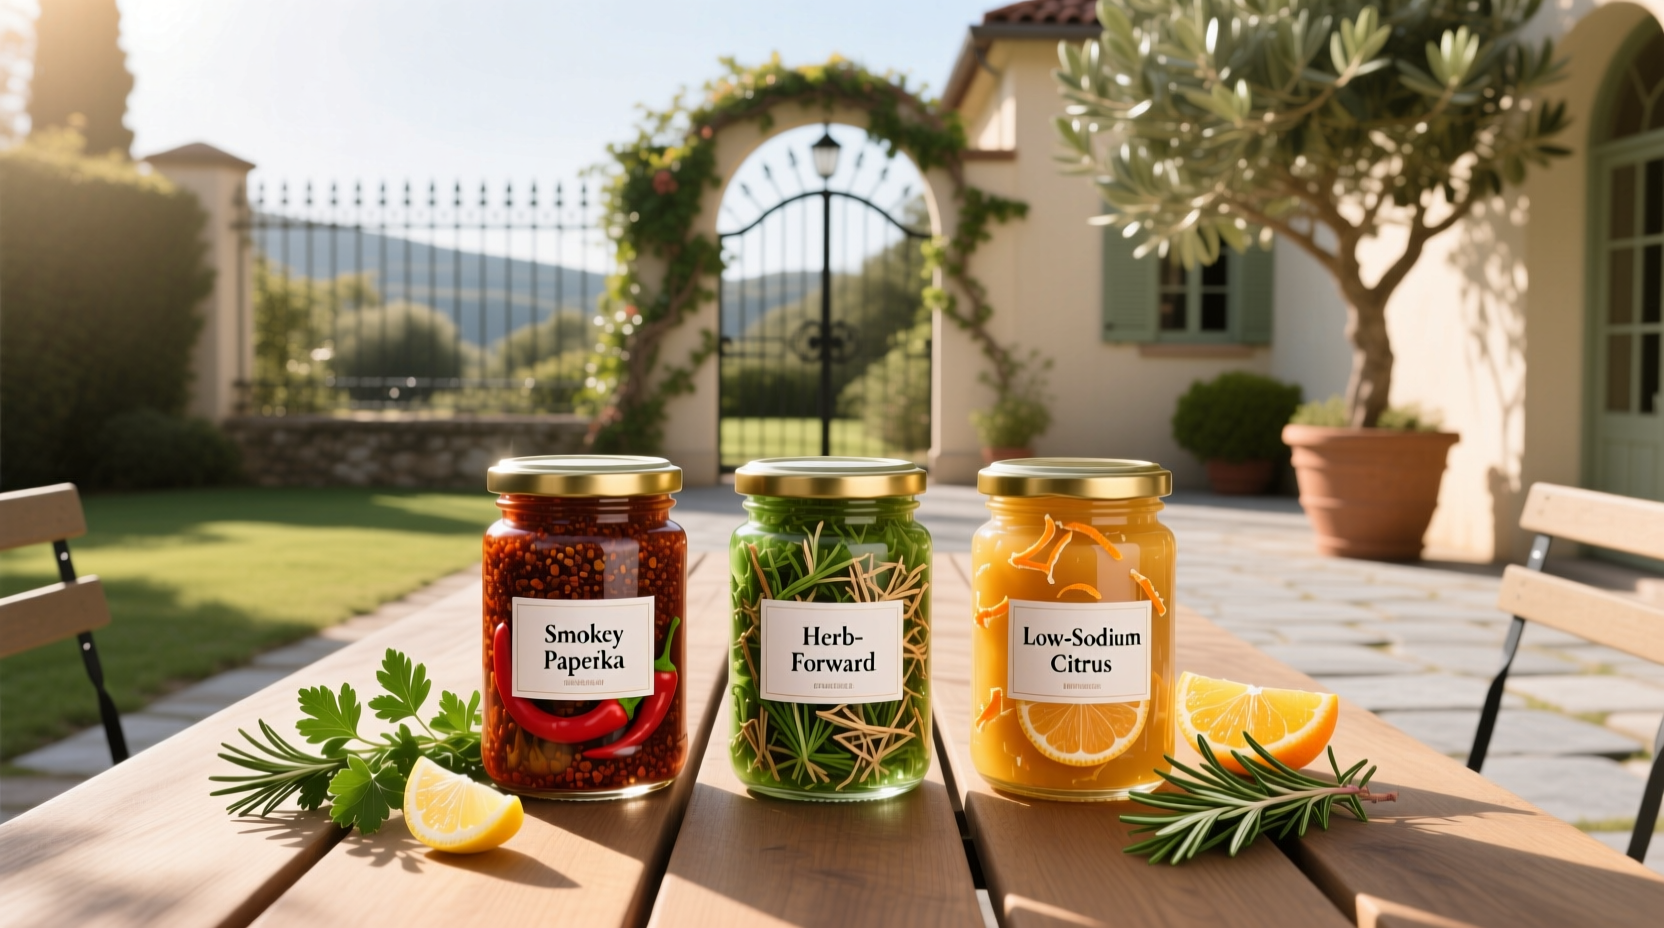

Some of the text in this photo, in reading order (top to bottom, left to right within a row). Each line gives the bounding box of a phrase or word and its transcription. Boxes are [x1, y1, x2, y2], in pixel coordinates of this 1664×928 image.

[544, 623, 624, 649] Smokey
[803, 625, 864, 646] Herb-
[1023, 626, 1141, 647] Low-Sodium
[791, 651, 876, 672] Forward
[1050, 653, 1112, 673] Citrus
